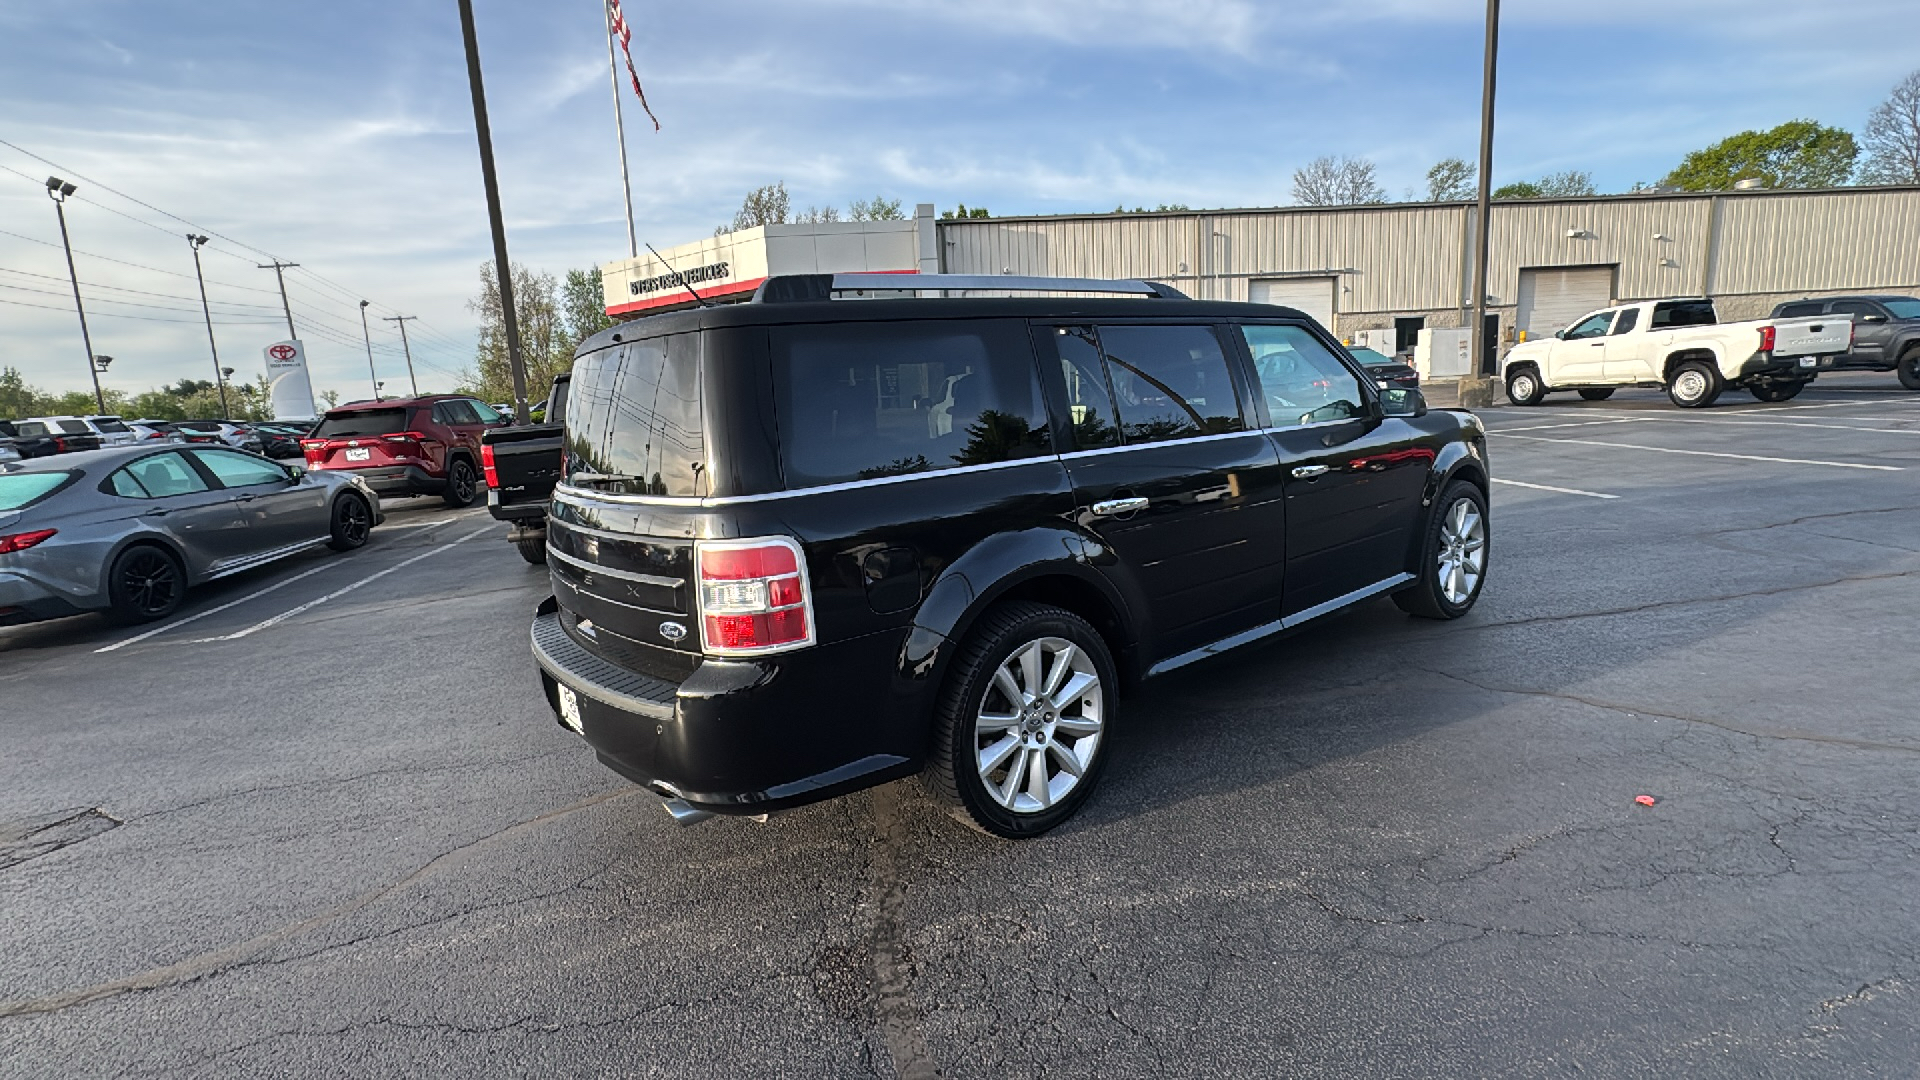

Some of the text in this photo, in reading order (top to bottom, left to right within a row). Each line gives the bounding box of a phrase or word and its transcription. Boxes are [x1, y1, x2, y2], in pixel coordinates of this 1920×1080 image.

[630, 262, 729, 295] BYERS USED VEHICLES
